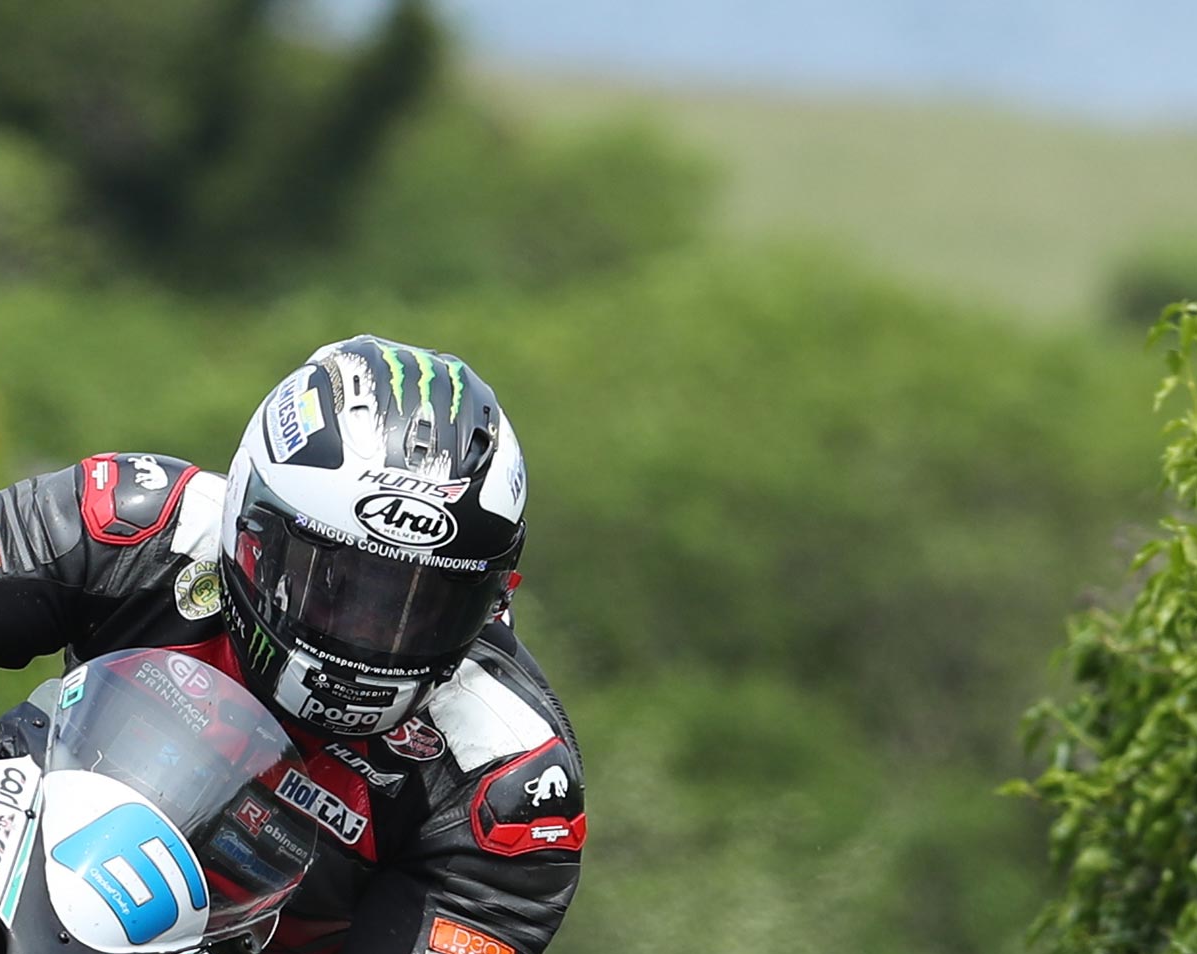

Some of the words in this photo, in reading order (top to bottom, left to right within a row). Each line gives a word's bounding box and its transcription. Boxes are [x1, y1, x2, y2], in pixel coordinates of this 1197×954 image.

[360, 497, 444, 538] Arai
[306, 519, 355, 547] ANGUS
[357, 538, 418, 563] COUNTY
[418, 555, 479, 572] WINDOWS
[294, 636, 431, 676] www.prosperity-wealth.co.uk
